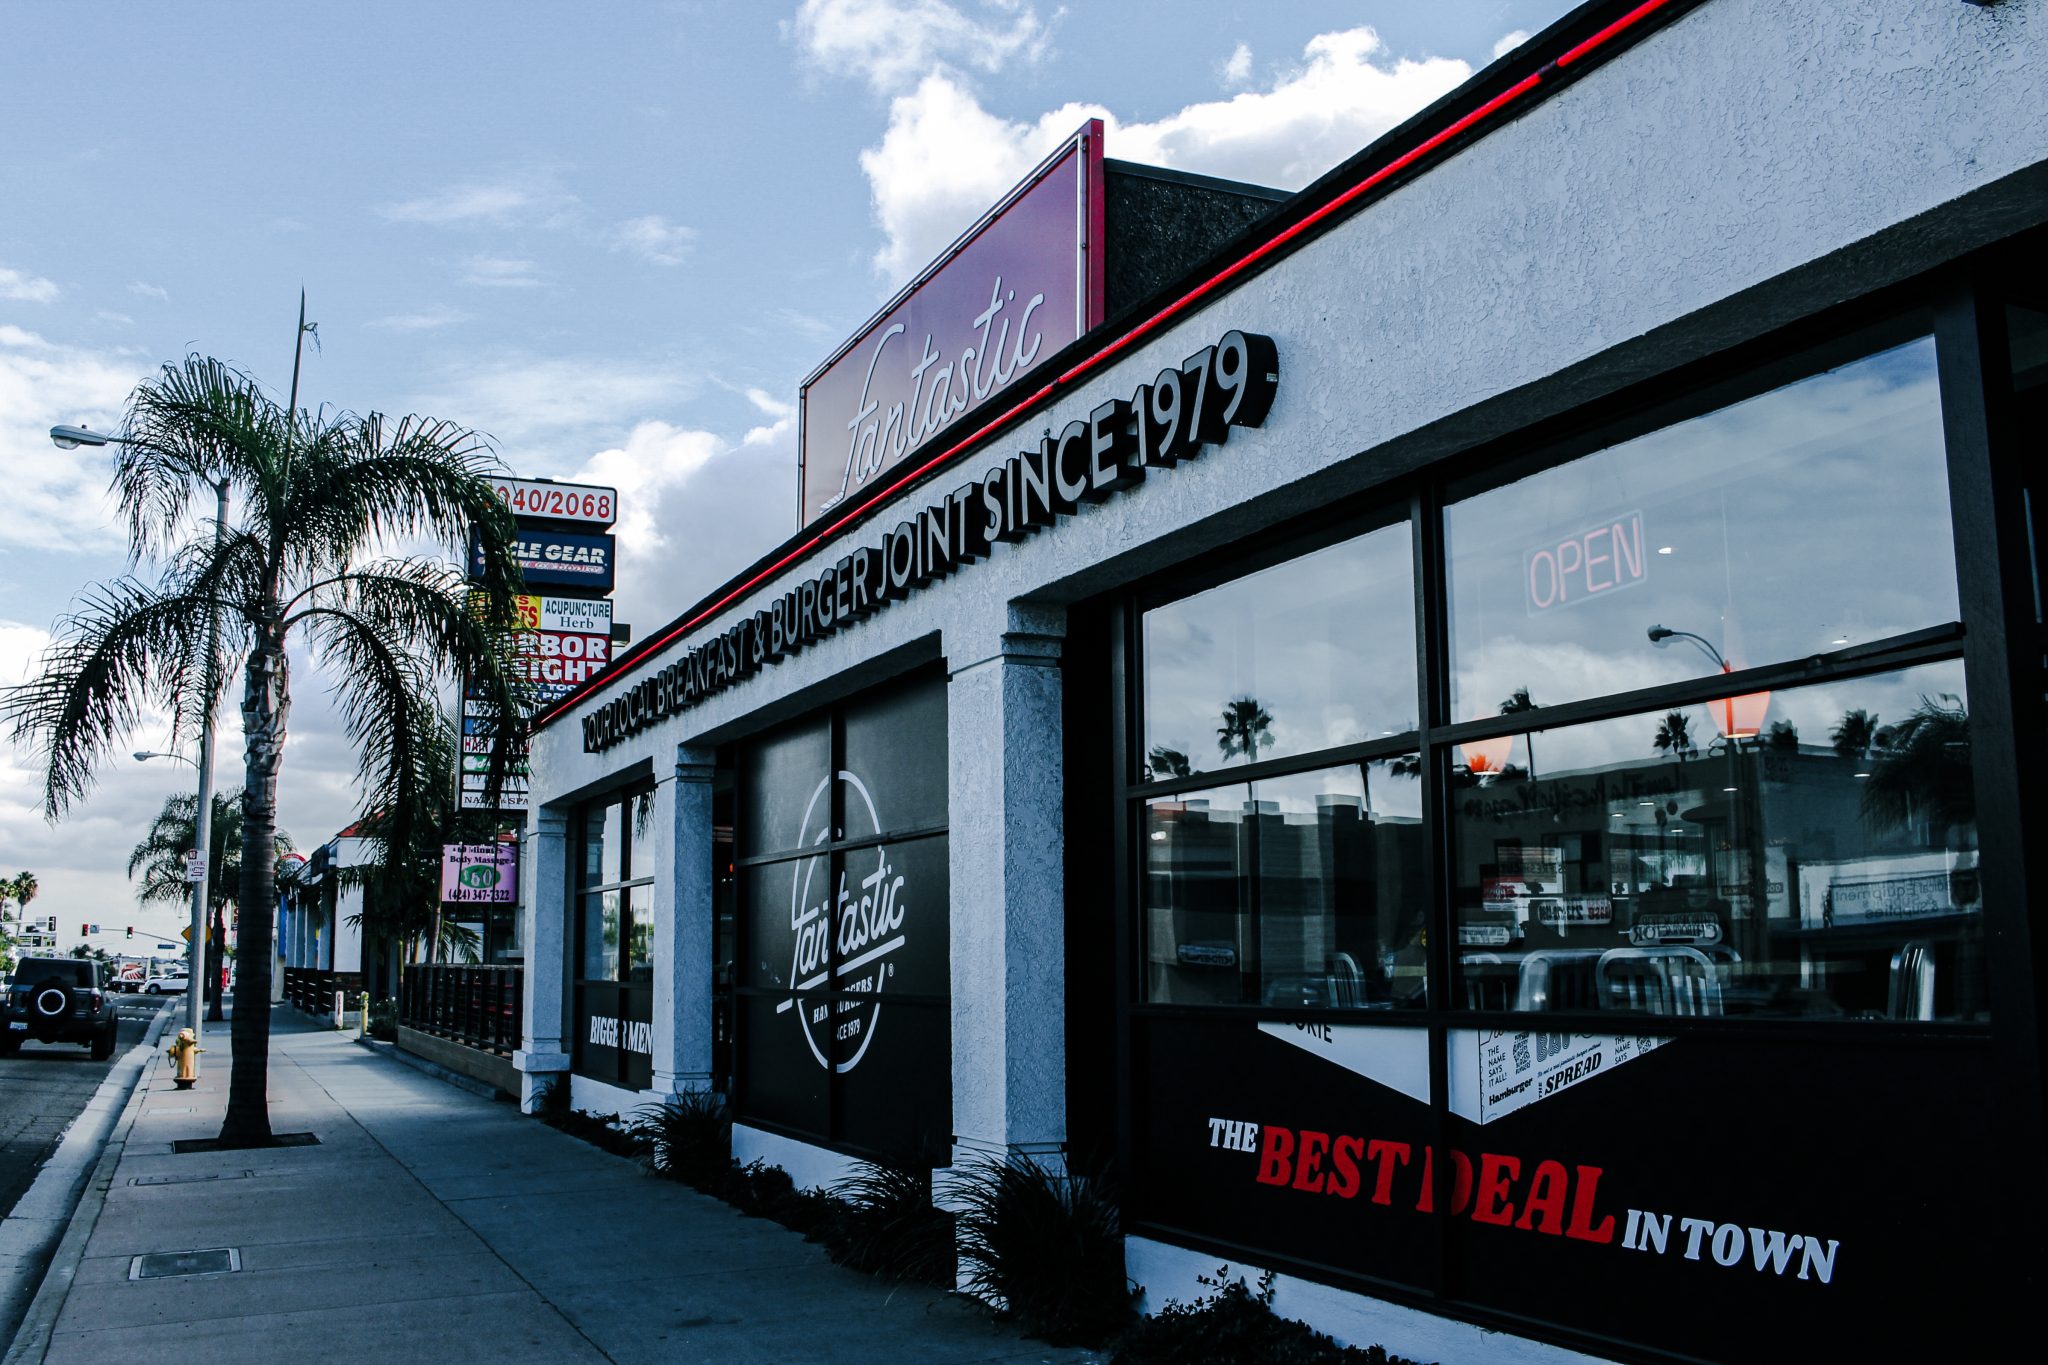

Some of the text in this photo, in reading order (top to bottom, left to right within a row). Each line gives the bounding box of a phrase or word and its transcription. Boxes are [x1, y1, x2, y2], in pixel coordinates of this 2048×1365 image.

[582, 329, 1248, 749] YOUR LOCAL BREAKFAST & BURGER JOINT SINCE 1979
[544, 544, 606, 564] GEAR
[1529, 516, 1642, 608] OPEN
[545, 600, 610, 618] ACUPUNCTURE
[560, 616, 594, 629] Herb
[1488, 1045, 1500, 1057] THE
[1488, 1052, 1507, 1068] NAME
[1488, 1064, 1503, 1078] SAYS
[1545, 1052, 1602, 1096] SPREAD
[1489, 1077, 1534, 1106] Hamburger
[1208, 1117, 1841, 1284] THE BEST DEAL IN TOWN
